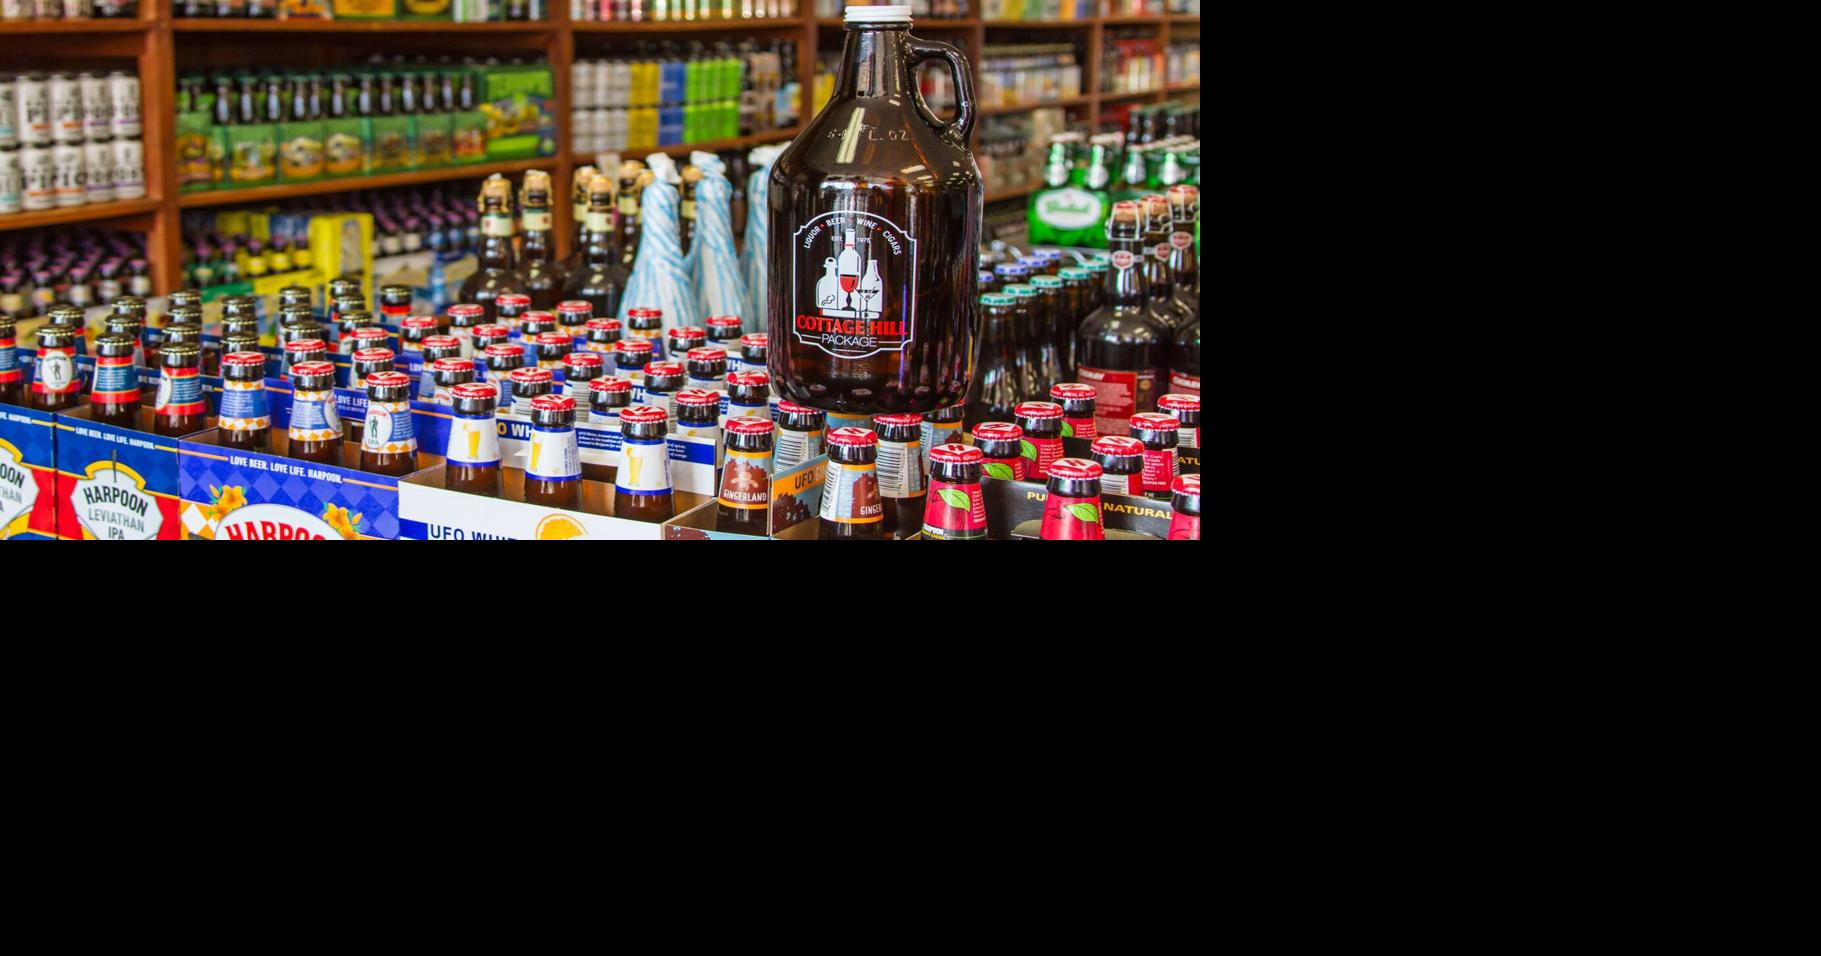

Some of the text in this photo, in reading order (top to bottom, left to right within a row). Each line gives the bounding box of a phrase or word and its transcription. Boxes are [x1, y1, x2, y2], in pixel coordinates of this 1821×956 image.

[803, 217, 902, 256] LIQUOR BEER WINE CIGARS
[796, 314, 908, 336] COTTAGE HILL
[821, 333, 878, 347] PACKAGE
[75, 426, 89, 437] LOVE
[103, 432, 117, 443] LOVE
[230, 456, 343, 483] LOVE BEER. LOVE LIFE. HARPOON.
[795, 470, 814, 490] UFO
[83, 488, 148, 517] HARPOON
[723, 490, 767, 502] GINGERLAND
[88, 508, 144, 532] LEVIATHAN
[108, 526, 124, 540] IPA
[224, 521, 326, 540] HARPO
[430, 524, 464, 540] UFO
